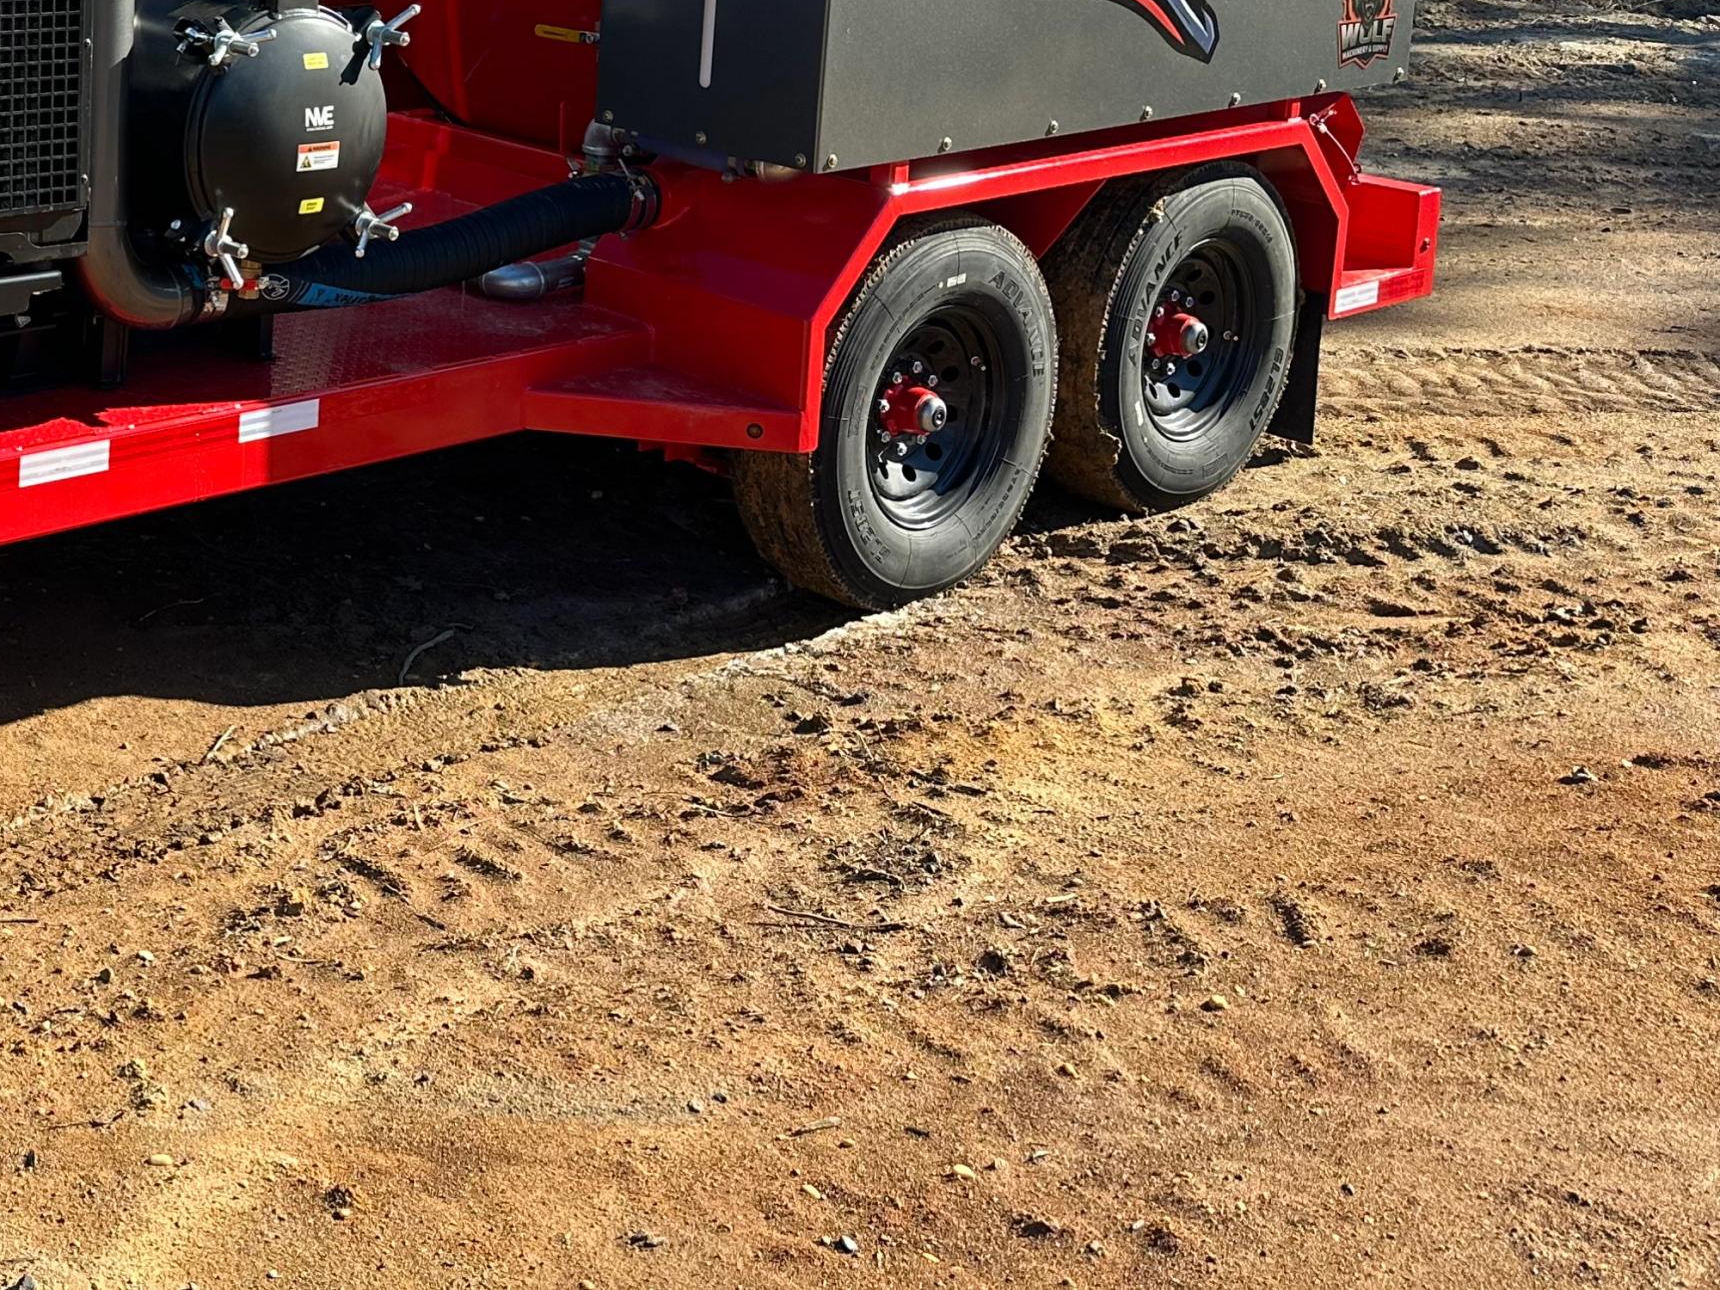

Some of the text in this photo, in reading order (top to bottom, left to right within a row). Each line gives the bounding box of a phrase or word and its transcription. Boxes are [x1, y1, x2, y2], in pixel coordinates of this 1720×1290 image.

[1340, 18, 1395, 51] WOLF
[304, 105, 335, 127] NVE
[987, 270, 1046, 377] ADVANCE
[1128, 232, 1185, 368] ADVANCE
